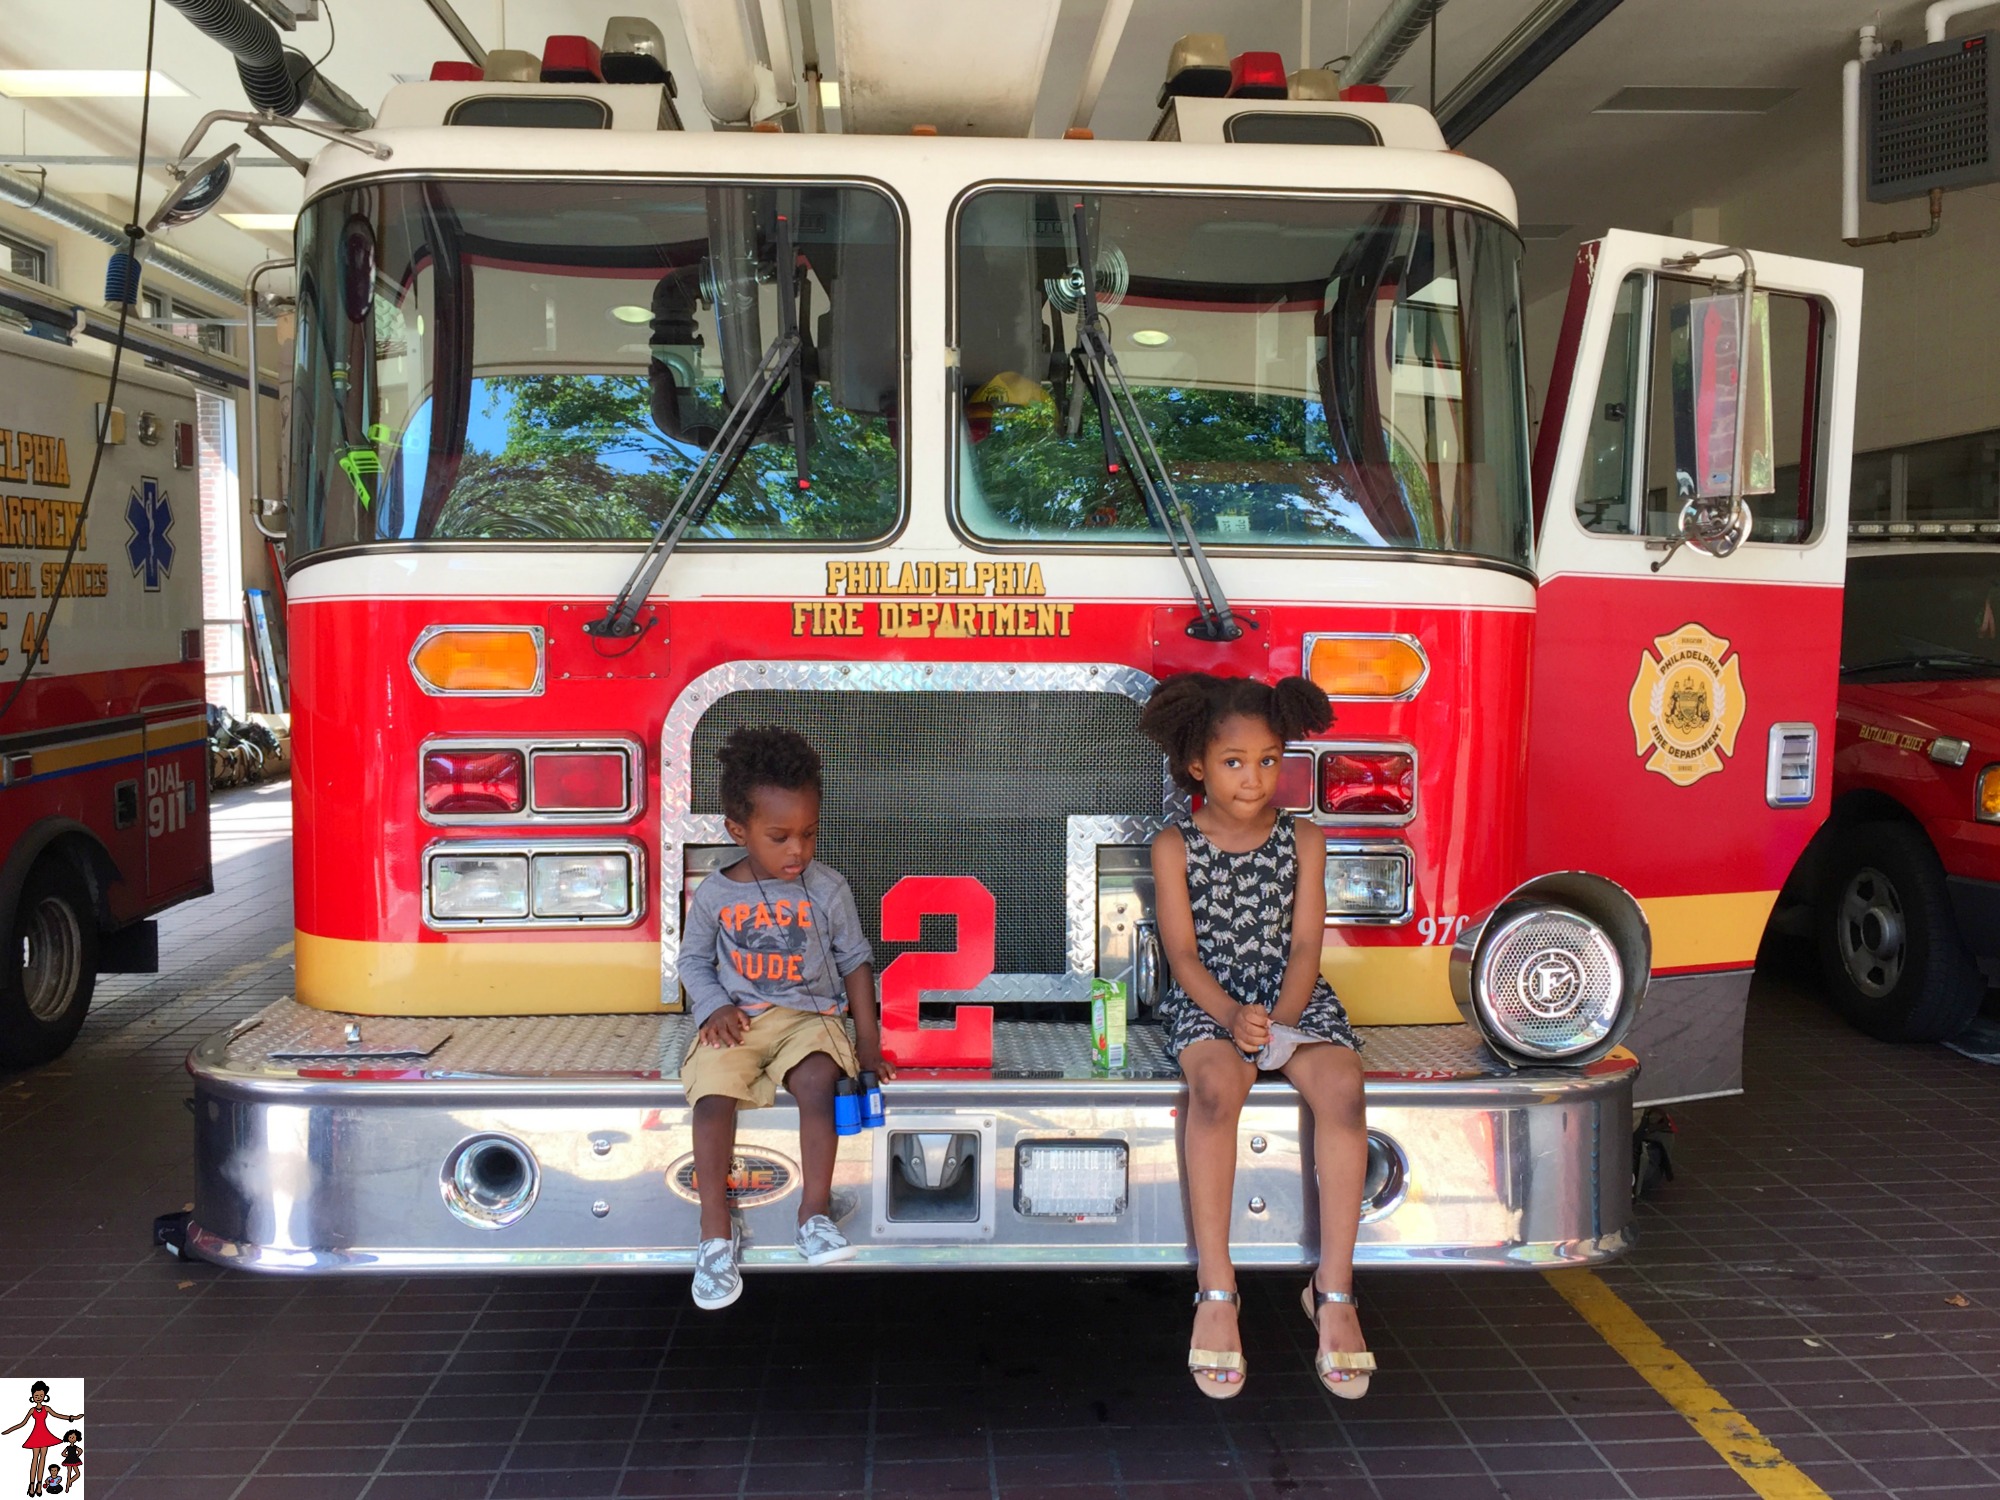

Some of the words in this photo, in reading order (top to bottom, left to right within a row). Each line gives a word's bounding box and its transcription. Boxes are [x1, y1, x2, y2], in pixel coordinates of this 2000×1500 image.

[826, 561, 1046, 595] PHILADELPHIA
[792, 602, 863, 637] FIRE
[878, 602, 1074, 638] DEPARTMENT
[21, 612, 49, 664] 44
[1660, 650, 1720, 678] PHILADELPHIA
[1651, 725, 1668, 748] FIRE
[1668, 725, 1722, 759] DEPARTMENT
[147, 762, 184, 796] DIAL
[149, 790, 185, 837] 911
[879, 876, 995, 1067] 2
